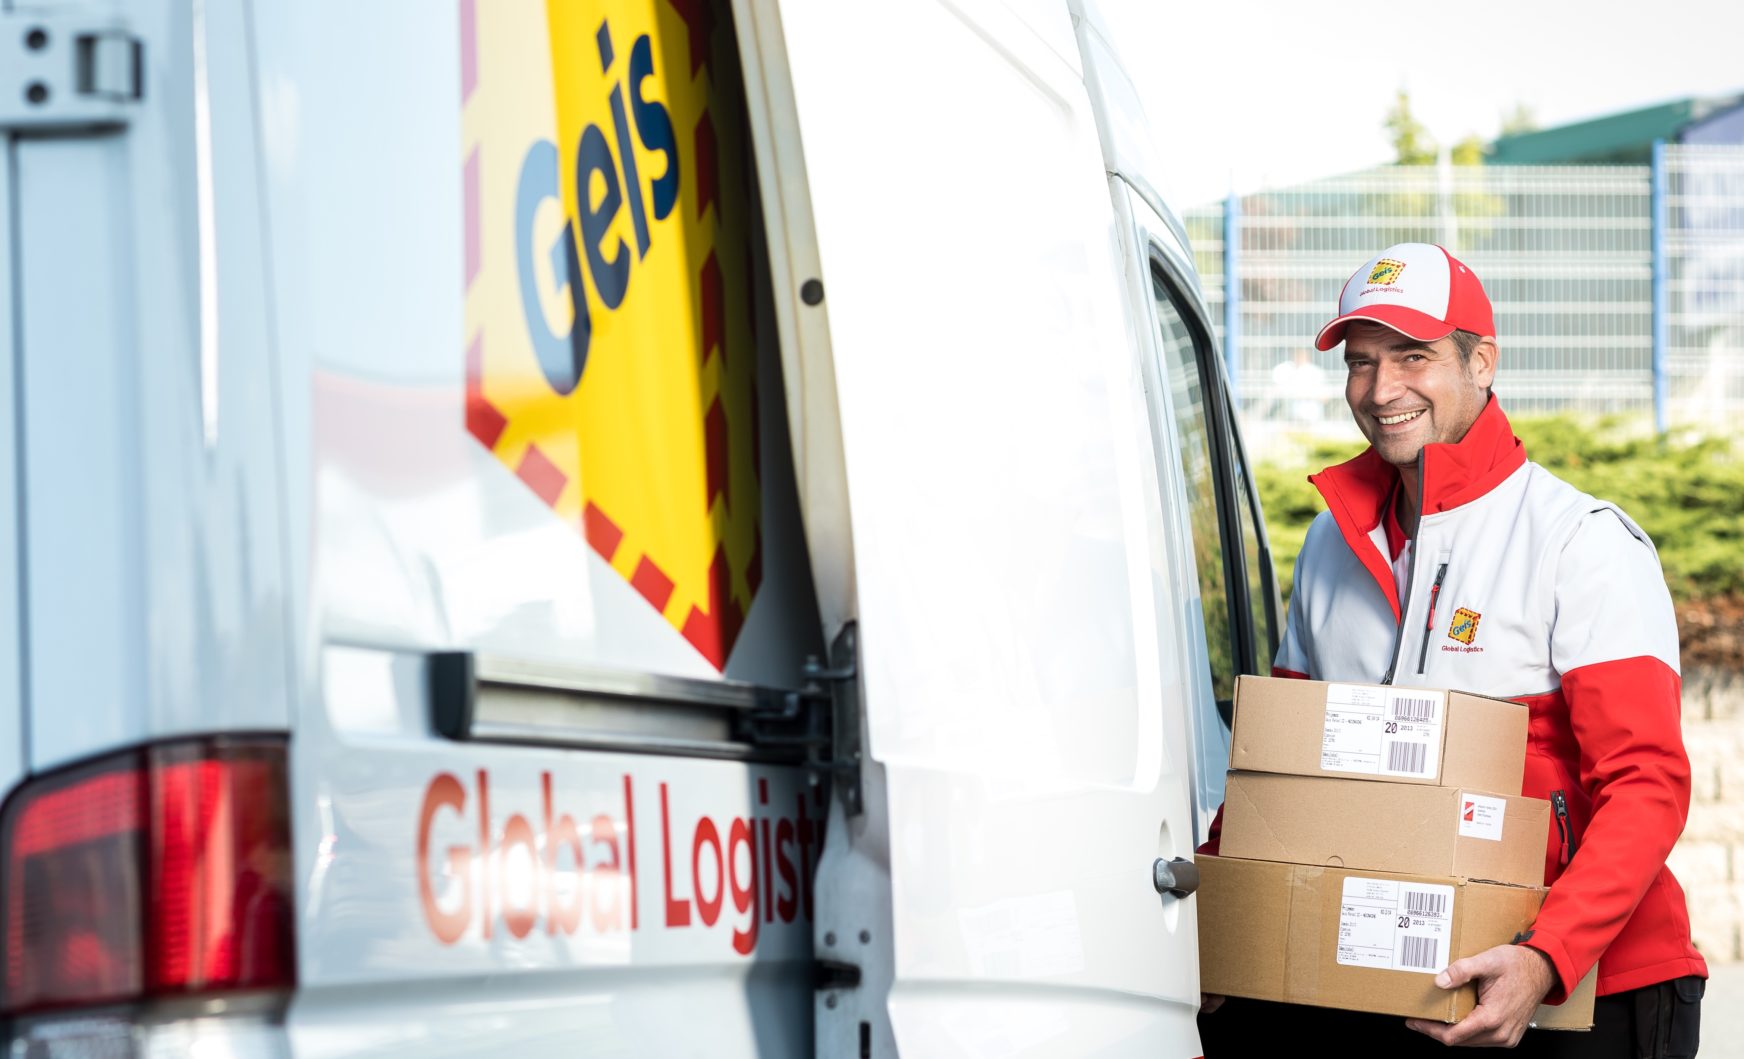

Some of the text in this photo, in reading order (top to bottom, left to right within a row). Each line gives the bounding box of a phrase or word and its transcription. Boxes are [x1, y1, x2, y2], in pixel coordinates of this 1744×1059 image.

[514, 17, 680, 397] Geis
[1372, 267, 1393, 280] Geis
[1376, 286, 1404, 294] Logistics
[1453, 619, 1472, 636] Geis
[1441, 645, 1484, 654] Global Logistics
[1384, 721, 1398, 734] 20
[415, 767, 638, 945] Global
[1397, 916, 1411, 929] 20
